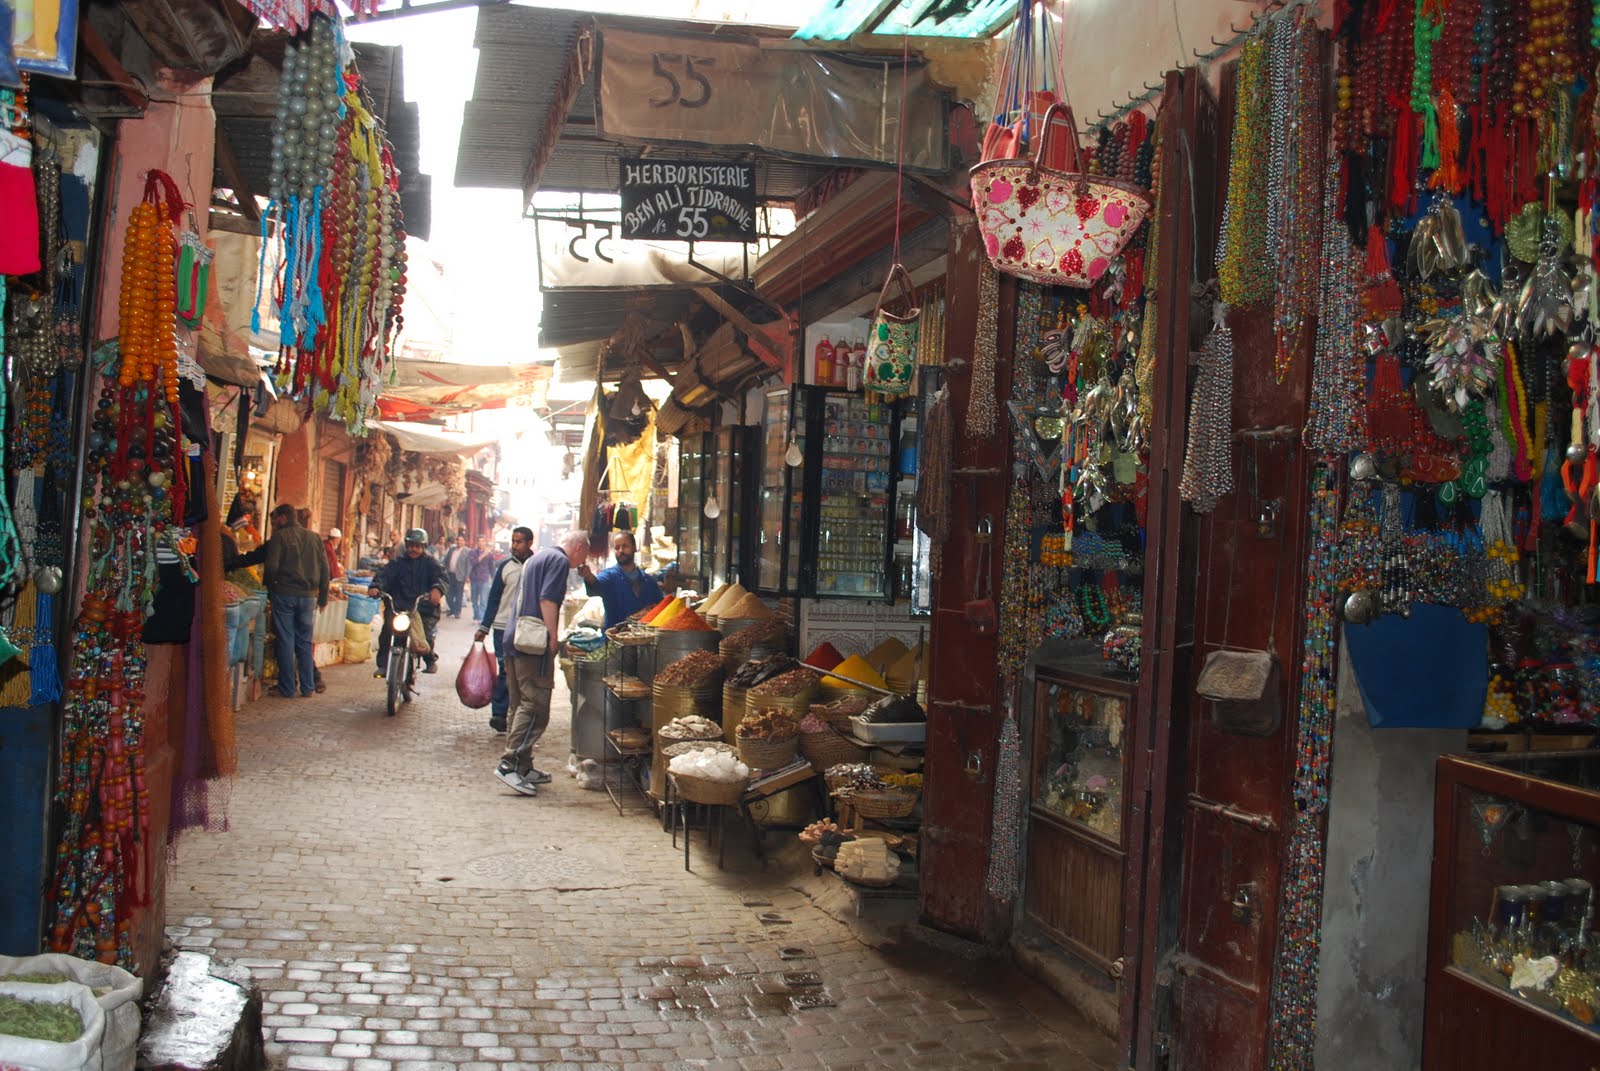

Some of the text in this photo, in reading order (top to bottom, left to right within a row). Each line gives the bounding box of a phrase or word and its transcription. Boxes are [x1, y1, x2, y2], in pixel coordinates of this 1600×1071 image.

[649, 52, 716, 108] 55
[625, 164, 750, 188] HERBORISTERIE
[624, 198, 655, 234] BEN
[676, 206, 709, 237] 55
